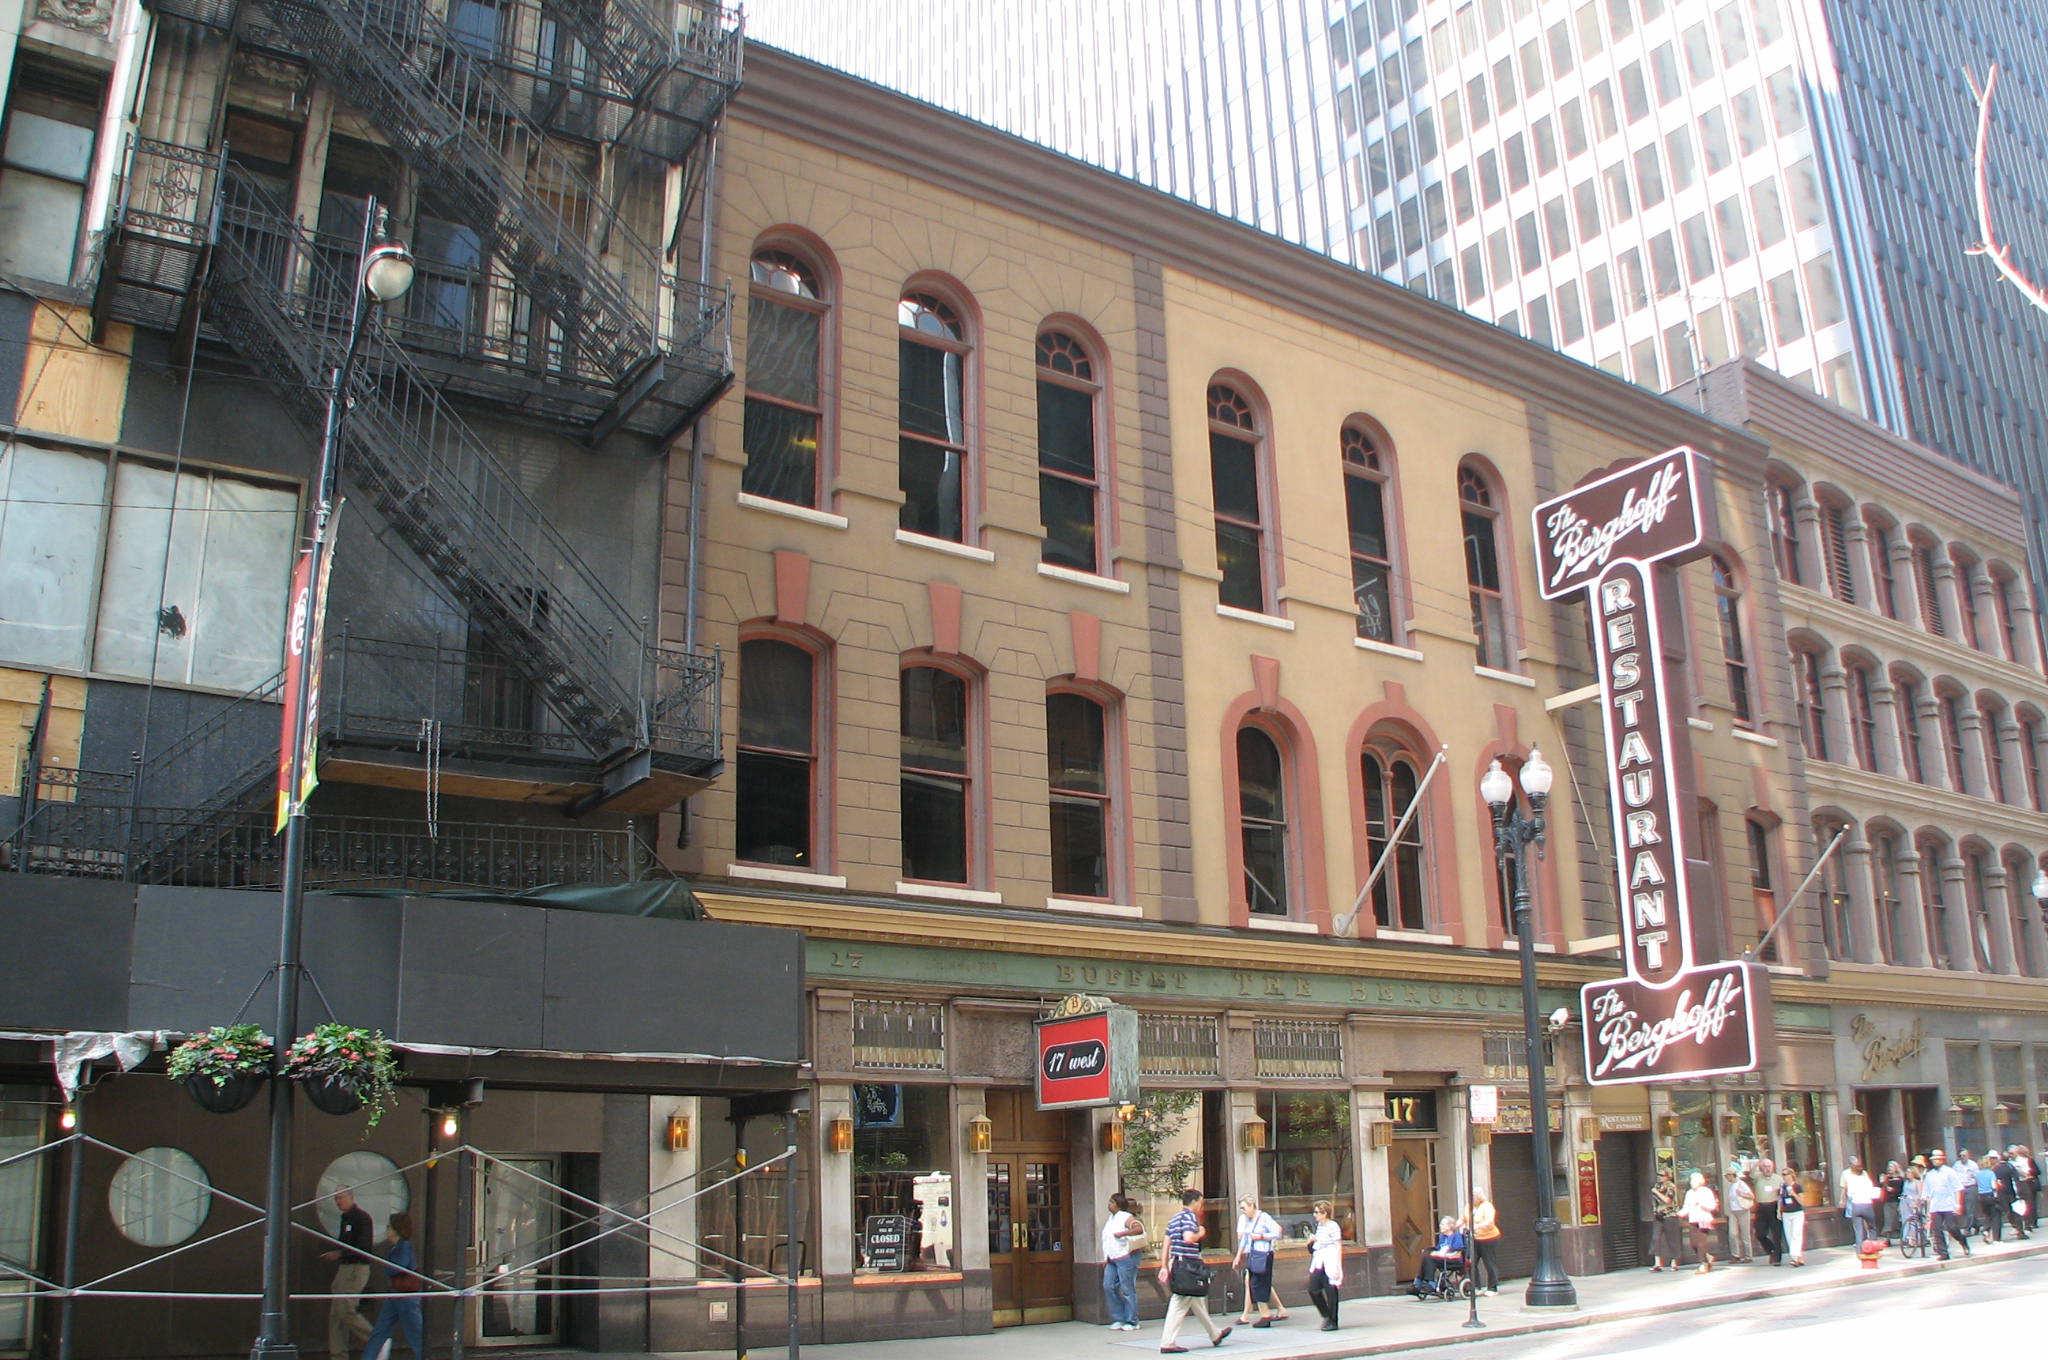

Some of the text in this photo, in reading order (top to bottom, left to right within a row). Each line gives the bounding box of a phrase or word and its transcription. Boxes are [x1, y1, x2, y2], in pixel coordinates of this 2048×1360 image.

[1547, 503, 1577, 538] The
[1551, 462, 1682, 588] Berghoff
[1601, 577, 1668, 969] RESTAURANT
[831, 952, 1524, 1009] 17 BUFFET THE BERGHOF
[1592, 988, 1627, 1022] The
[1594, 972, 1742, 1076] Berghoff
[1048, 1046, 1101, 1073] 17 west
[1390, 1097, 1414, 1121] 17
[871, 1234, 900, 1243] CLOSED
